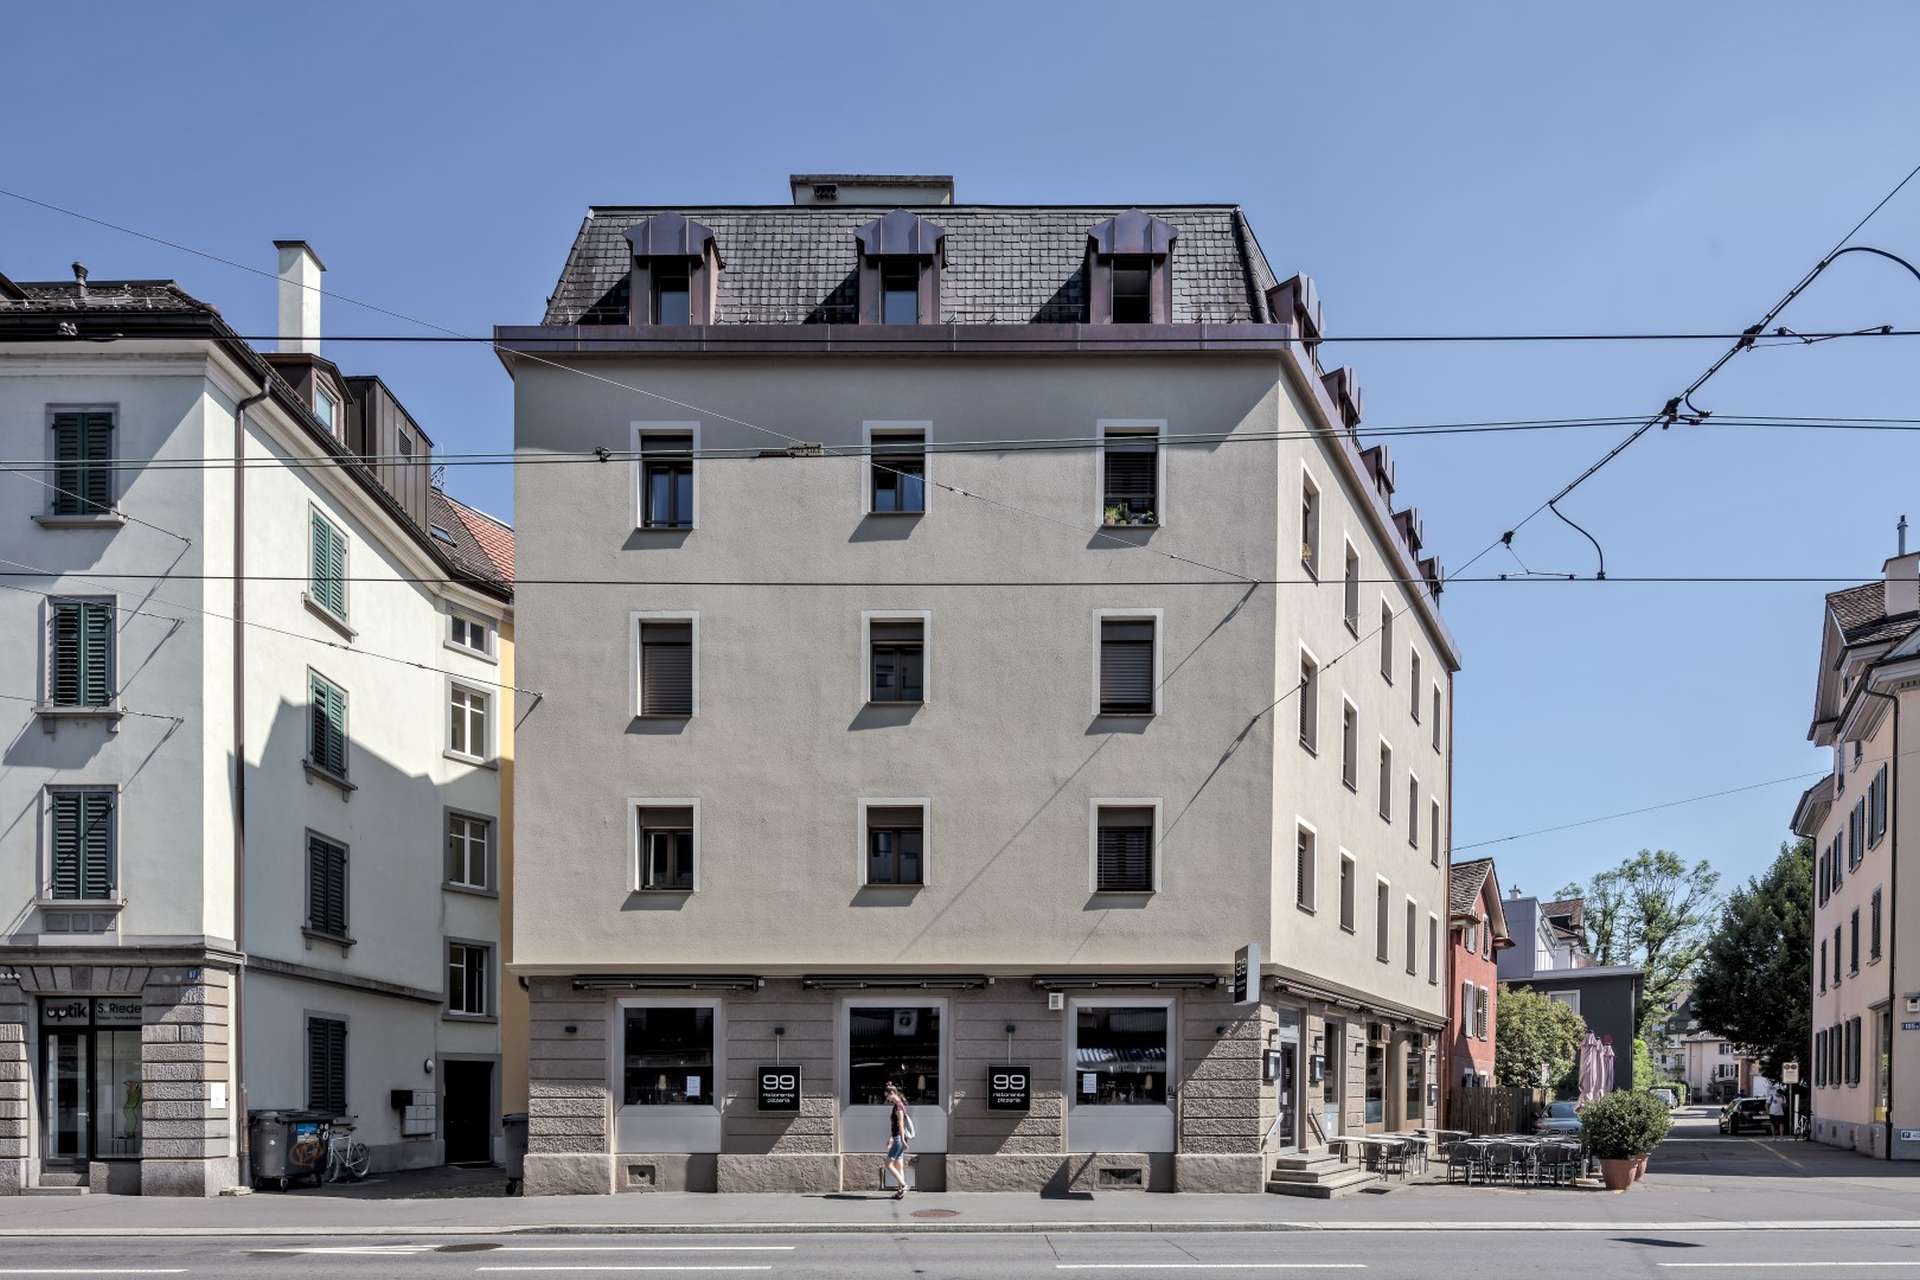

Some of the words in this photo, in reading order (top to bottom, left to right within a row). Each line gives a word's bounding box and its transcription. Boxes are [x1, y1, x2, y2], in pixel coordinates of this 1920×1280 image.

[46, 1002, 87, 1022] optik
[763, 1074, 795, 1090] 99
[993, 1074, 1025, 1090] 99
